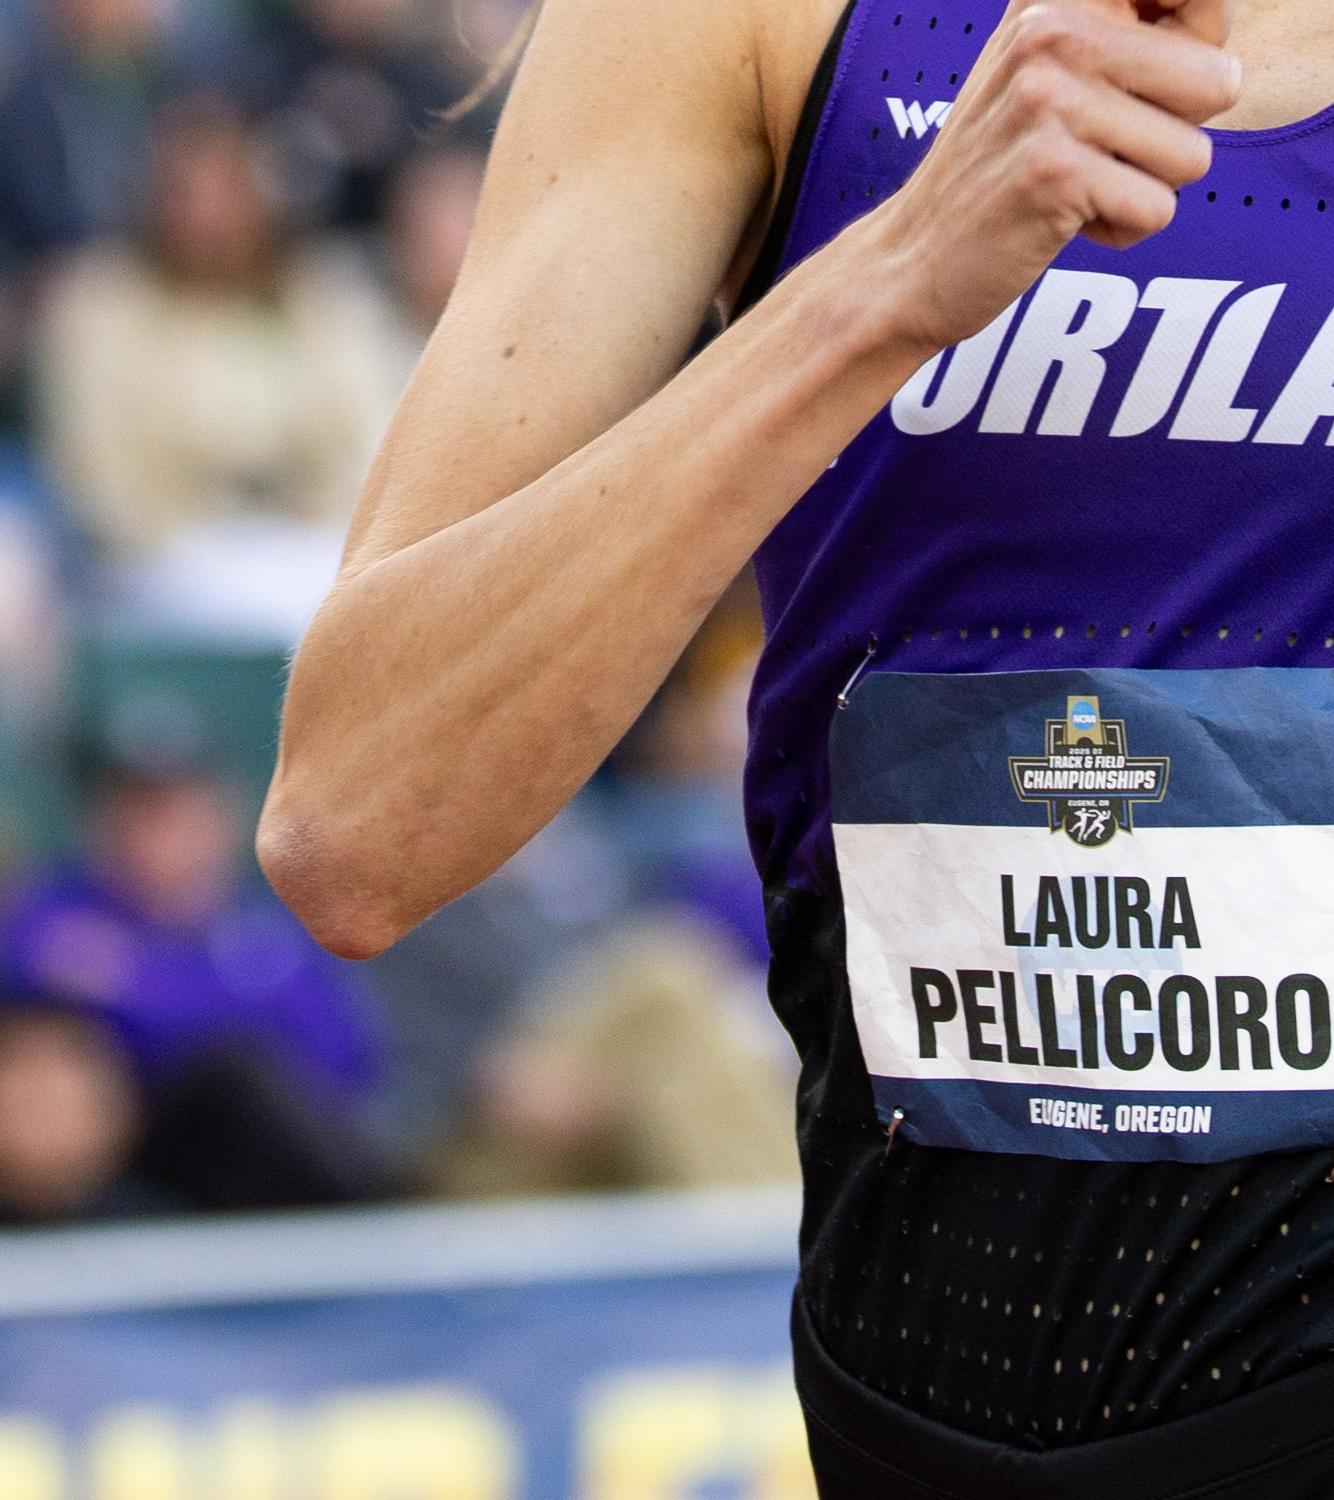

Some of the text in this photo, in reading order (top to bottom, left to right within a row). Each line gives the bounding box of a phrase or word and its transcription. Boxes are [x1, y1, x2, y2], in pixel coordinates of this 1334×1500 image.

[1072, 714, 1097, 724] NCAA
[1049, 756, 1125, 769] TRACK & FIELD
[1023, 770, 1156, 790] CHAMPIONSHIPS
[1000, 874, 1201, 949] LAURA
[909, 966, 1331, 1071] PELLICORO
[1029, 1098, 1211, 1133] EUGENE, OREGON
